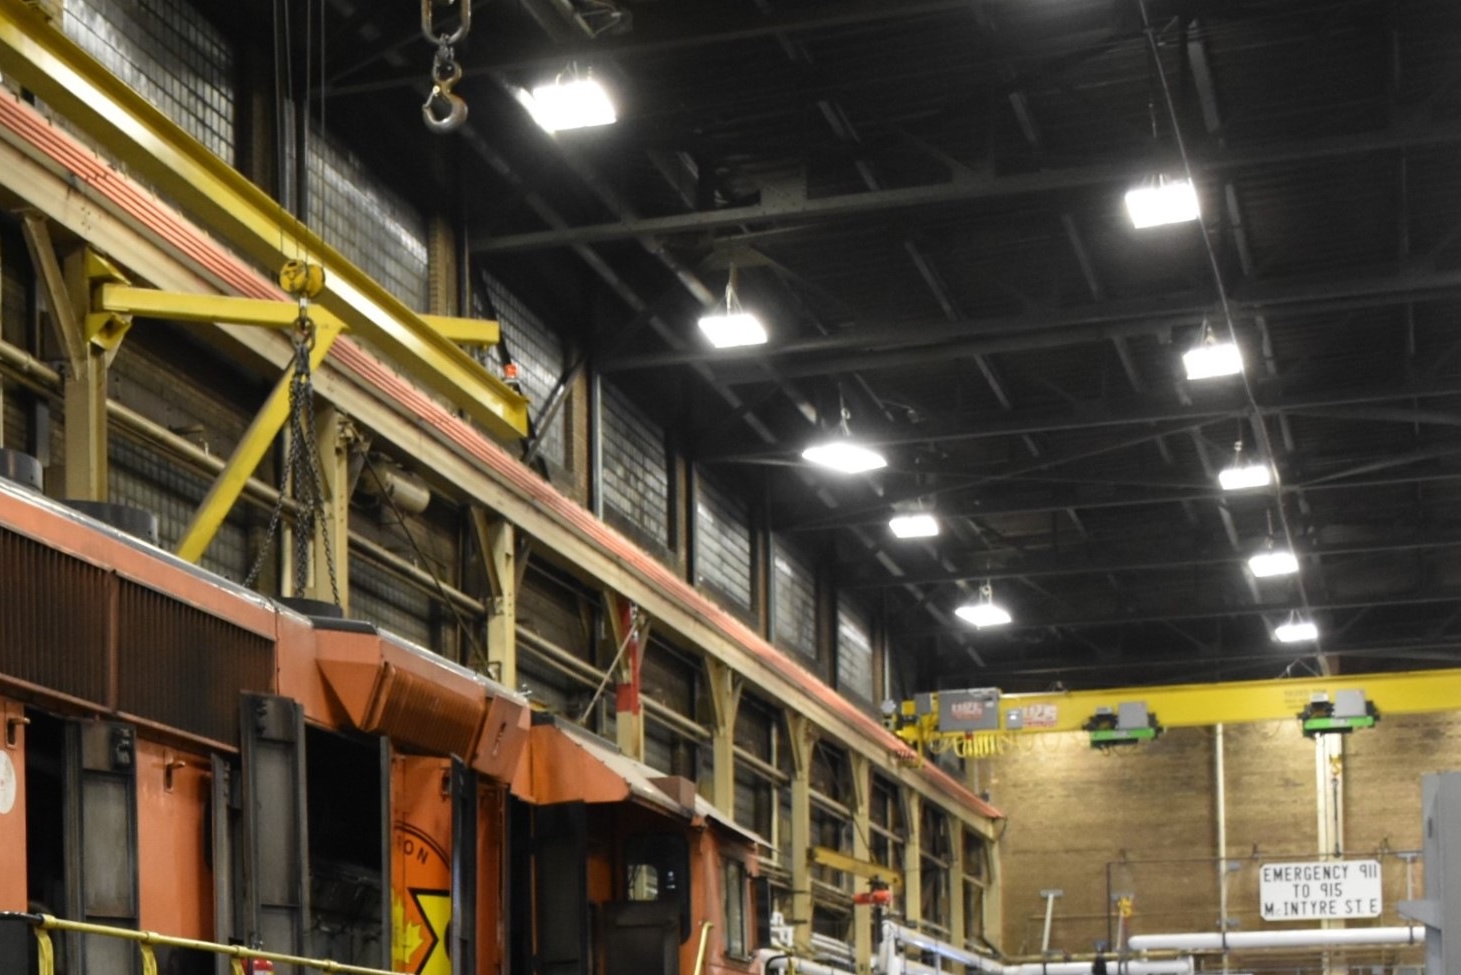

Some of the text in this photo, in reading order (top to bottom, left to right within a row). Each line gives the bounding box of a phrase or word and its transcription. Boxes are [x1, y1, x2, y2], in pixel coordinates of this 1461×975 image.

[1263, 863, 1378, 882] EMERGENCY 911
[1293, 882, 1343, 899] TO 915
[1369, 898, 1378, 914] E
